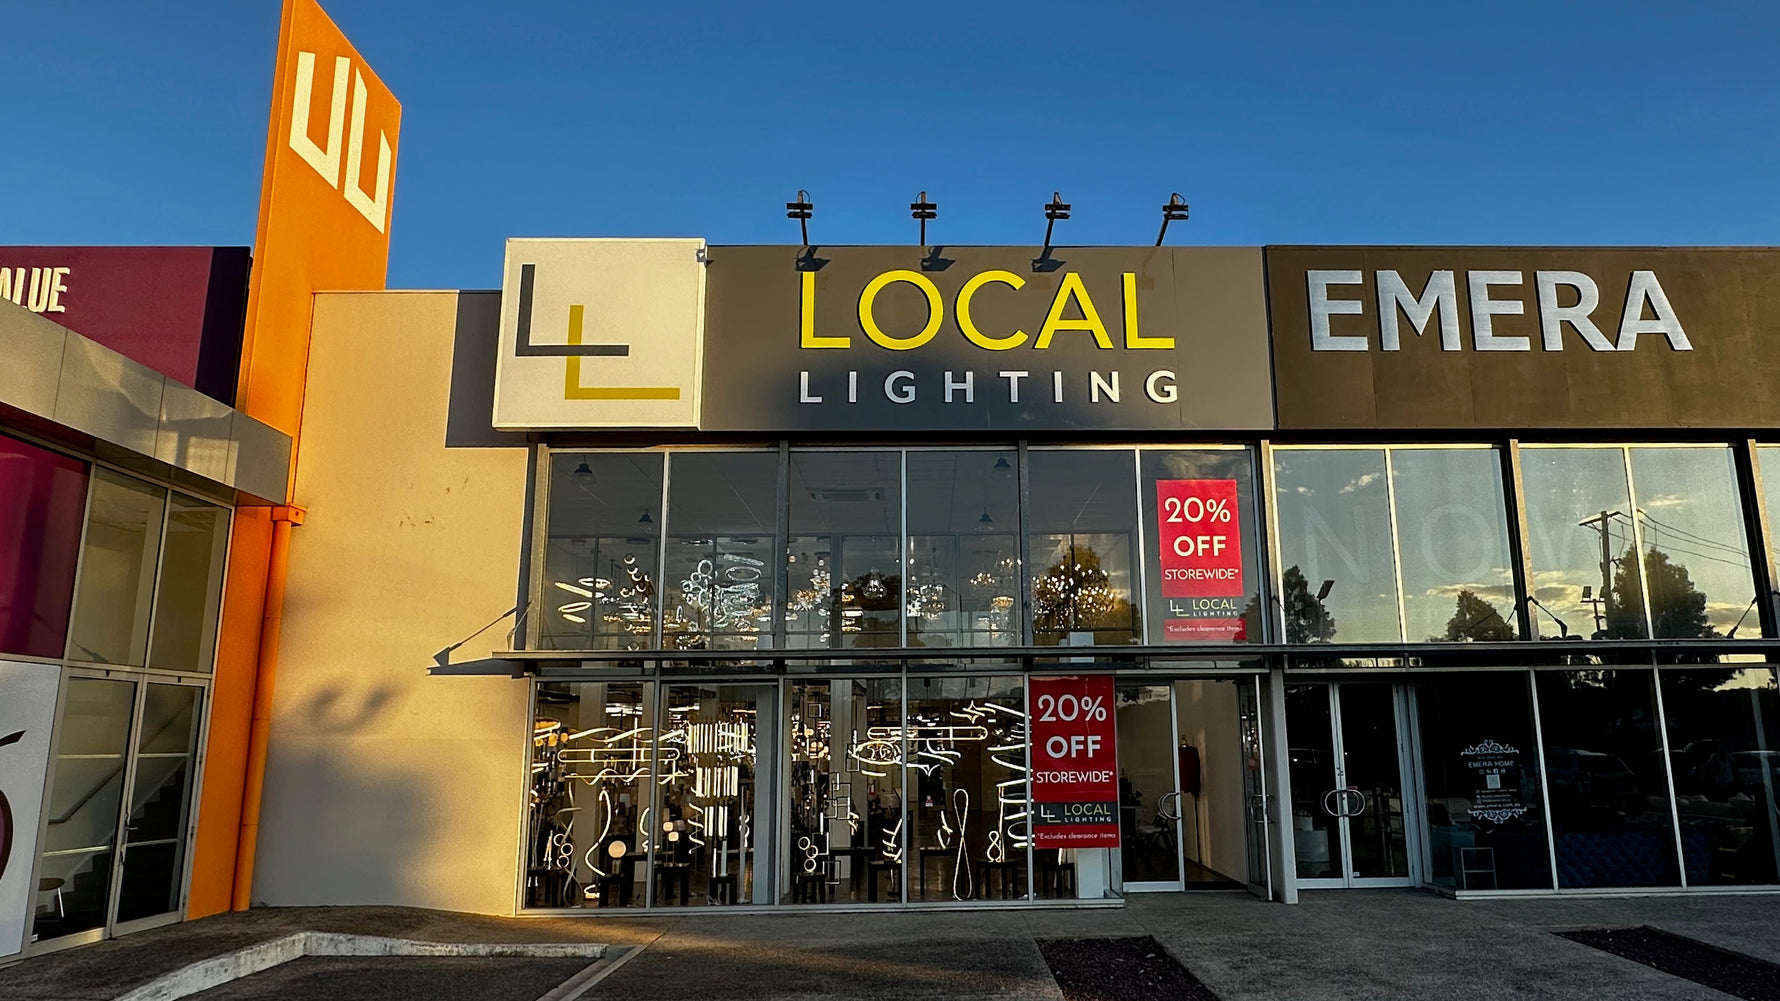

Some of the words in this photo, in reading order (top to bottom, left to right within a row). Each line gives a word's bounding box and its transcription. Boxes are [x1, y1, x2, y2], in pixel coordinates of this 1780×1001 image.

[800, 270, 1176, 350] LOCAL
[1307, 270, 1694, 352] EMERA
[800, 370, 1180, 404] LIGHTING
[1164, 497, 1231, 523] 20%
[1173, 535, 1227, 557] OFF
[1192, 598, 1238, 610] LOCAL
[1037, 694, 1107, 722] 20%
[1045, 735, 1102, 759] OFF
[1064, 803, 1111, 816] LOCAL
[1068, 831, 1098, 840] clearance
